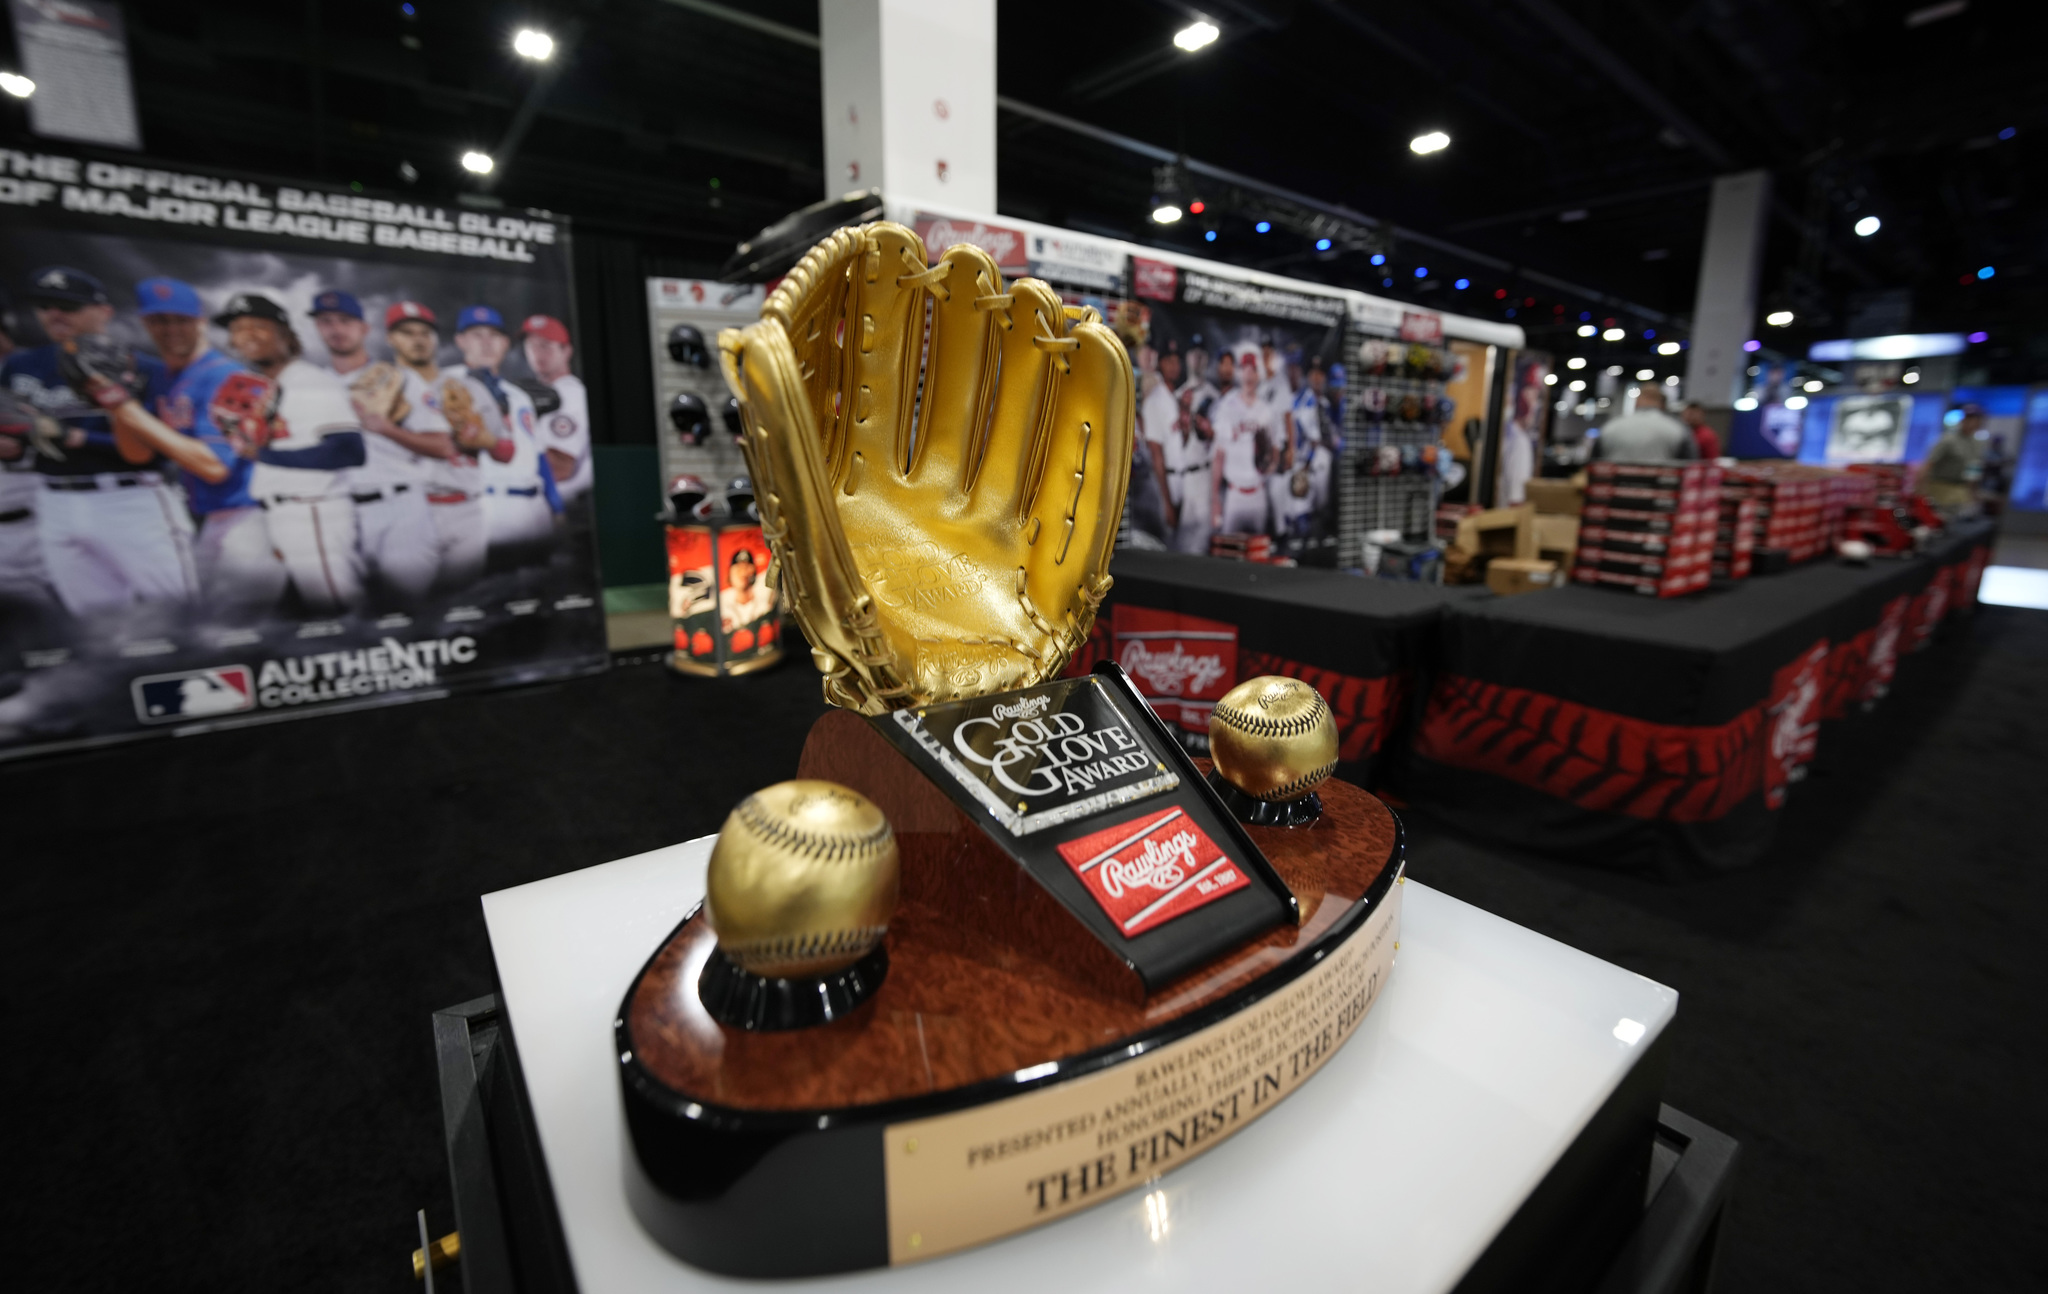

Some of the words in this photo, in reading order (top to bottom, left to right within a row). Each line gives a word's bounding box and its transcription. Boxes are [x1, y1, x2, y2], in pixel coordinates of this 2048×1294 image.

[0, 176, 57, 207] OF
[62, 185, 219, 227] MAJOR
[222, 204, 370, 244] LEAGUE
[373, 224, 535, 263] BASEBALL
[86, 161, 272, 208] OFFICIAL
[277, 187, 456, 232] BASEBALL
[458, 212, 556, 245] GLOVE
[914, 579, 983, 612] AWARD
[258, 636, 477, 688] AUTHENTIC
[259, 667, 437, 708] COLLECTION
[1120, 639, 1226, 694] Rawlings
[992, 693, 1051, 721] Rawlings
[953, 712, 1085, 767] GOLD
[992, 726, 1137, 797] GLOVE
[1066, 751, 1150, 797] AWARD
[1100, 830, 1197, 899] Rawlings
[1196, 878, 1219, 895] Est.
[1135, 1036, 1226, 1088] RAWLINGS
[1231, 1011, 1272, 1043] GOLD
[1274, 984, 1314, 1019] GLOVE
[966, 1112, 1096, 1169] PRESENTED
[1210, 1053, 1233, 1075] TO
[1236, 1035, 1263, 1061] THE
[1268, 1016, 1293, 1043] TOP
[1097, 1092, 1203, 1149] HONORING
[1208, 1063, 1250, 1097] THEIR
[1255, 1015, 1319, 1070] SELECTION
[1027, 1151, 1117, 1213] THE
[1127, 1086, 1246, 1176] FINEST
[1253, 1064, 1282, 1106] IN
[1288, 1021, 1334, 1077] THE
